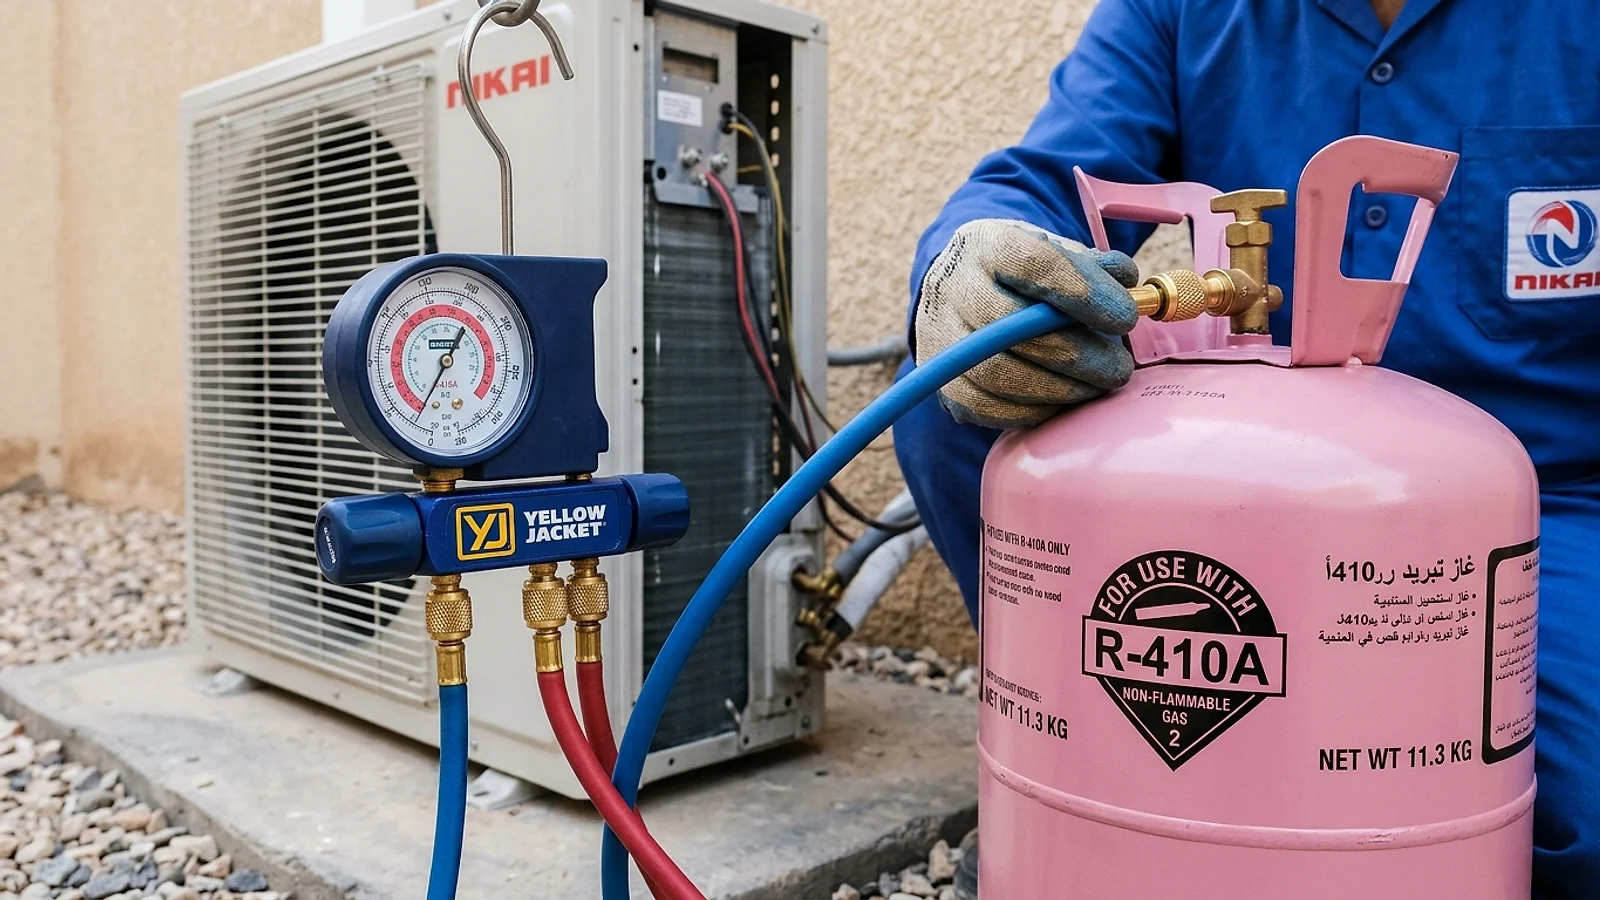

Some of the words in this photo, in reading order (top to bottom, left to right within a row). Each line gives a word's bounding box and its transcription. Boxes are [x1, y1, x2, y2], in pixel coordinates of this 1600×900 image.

[523, 505, 606, 526] YELLOW
[463, 512, 507, 551] YJ
[1048, 541, 1071, 556] ONLY
[1402, 558, 1444, 585] تبريد
[1449, 554, 1476, 582] غاز
[1098, 573, 1137, 618] FOR
[1137, 556, 1186, 584] USE
[1196, 561, 1258, 617] WITH
[1095, 627, 1270, 687] R-410A
[1122, 686, 1231, 712] NON-FLAMMABLE
[1000, 694, 1014, 719] WT
[1017, 705, 1043, 732] 11.3
[1048, 714, 1067, 740] KG
[1162, 710, 1188, 726] GAS
[1169, 729, 1180, 747] 2
[1319, 748, 1361, 771] NET
[1368, 748, 1401, 770] WT
[1407, 743, 1445, 768] 11.3
[1450, 739, 1472, 763] KG
